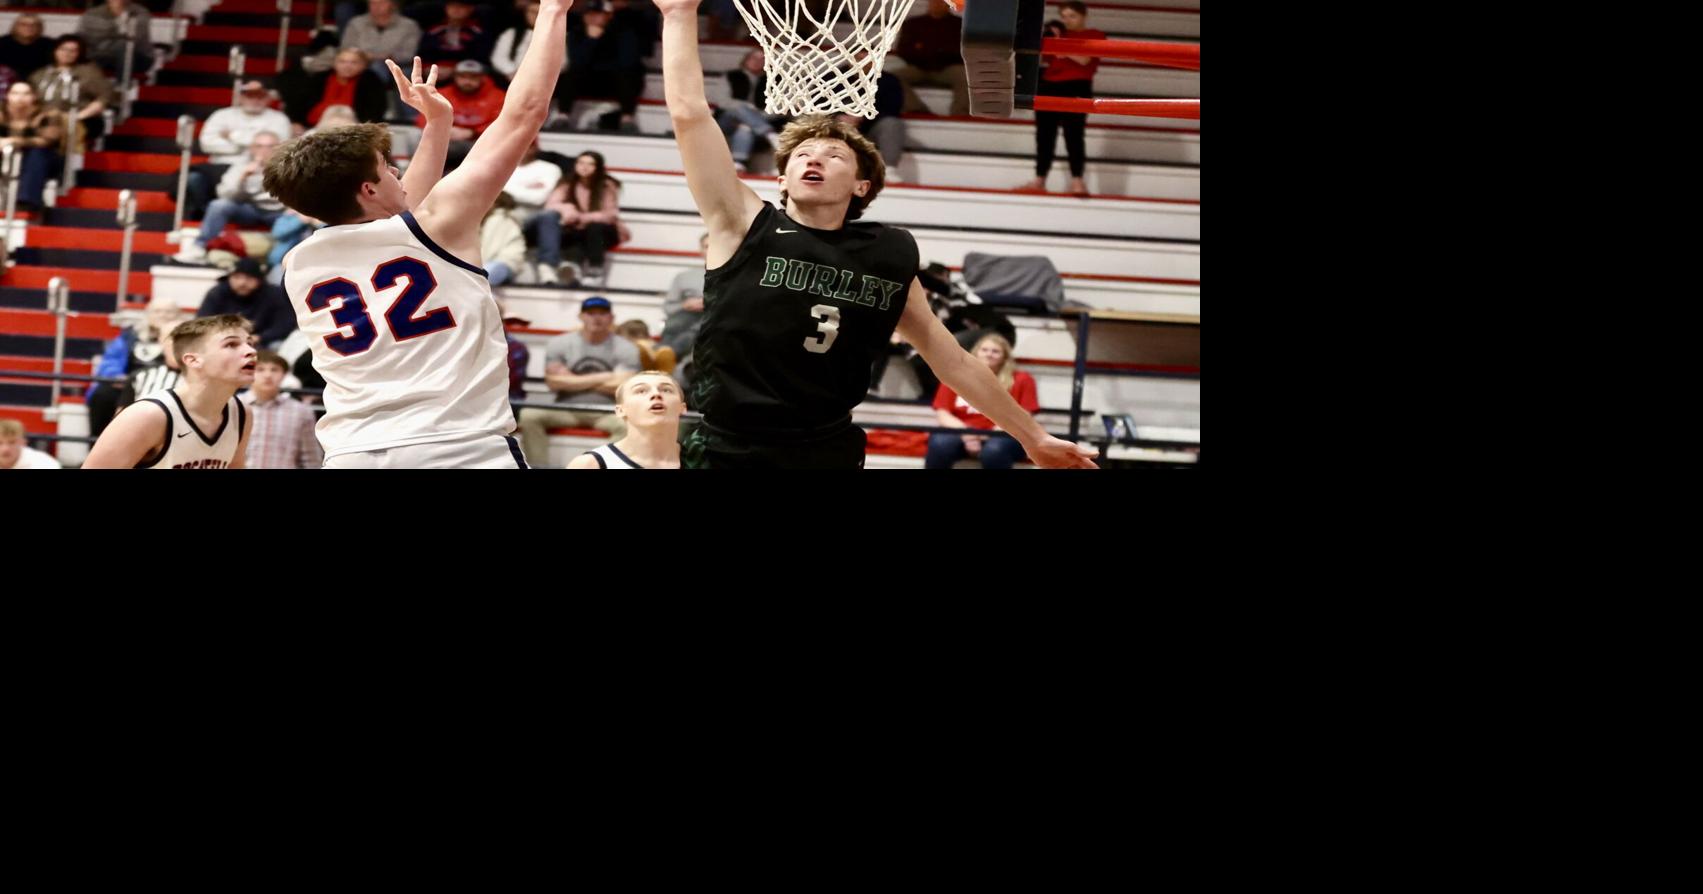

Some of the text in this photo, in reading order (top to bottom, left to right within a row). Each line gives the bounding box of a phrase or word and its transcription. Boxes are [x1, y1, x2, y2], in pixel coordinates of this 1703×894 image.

[305, 255, 457, 357] 32
[759, 256, 903, 311] BURLEY
[803, 304, 841, 354] 3
